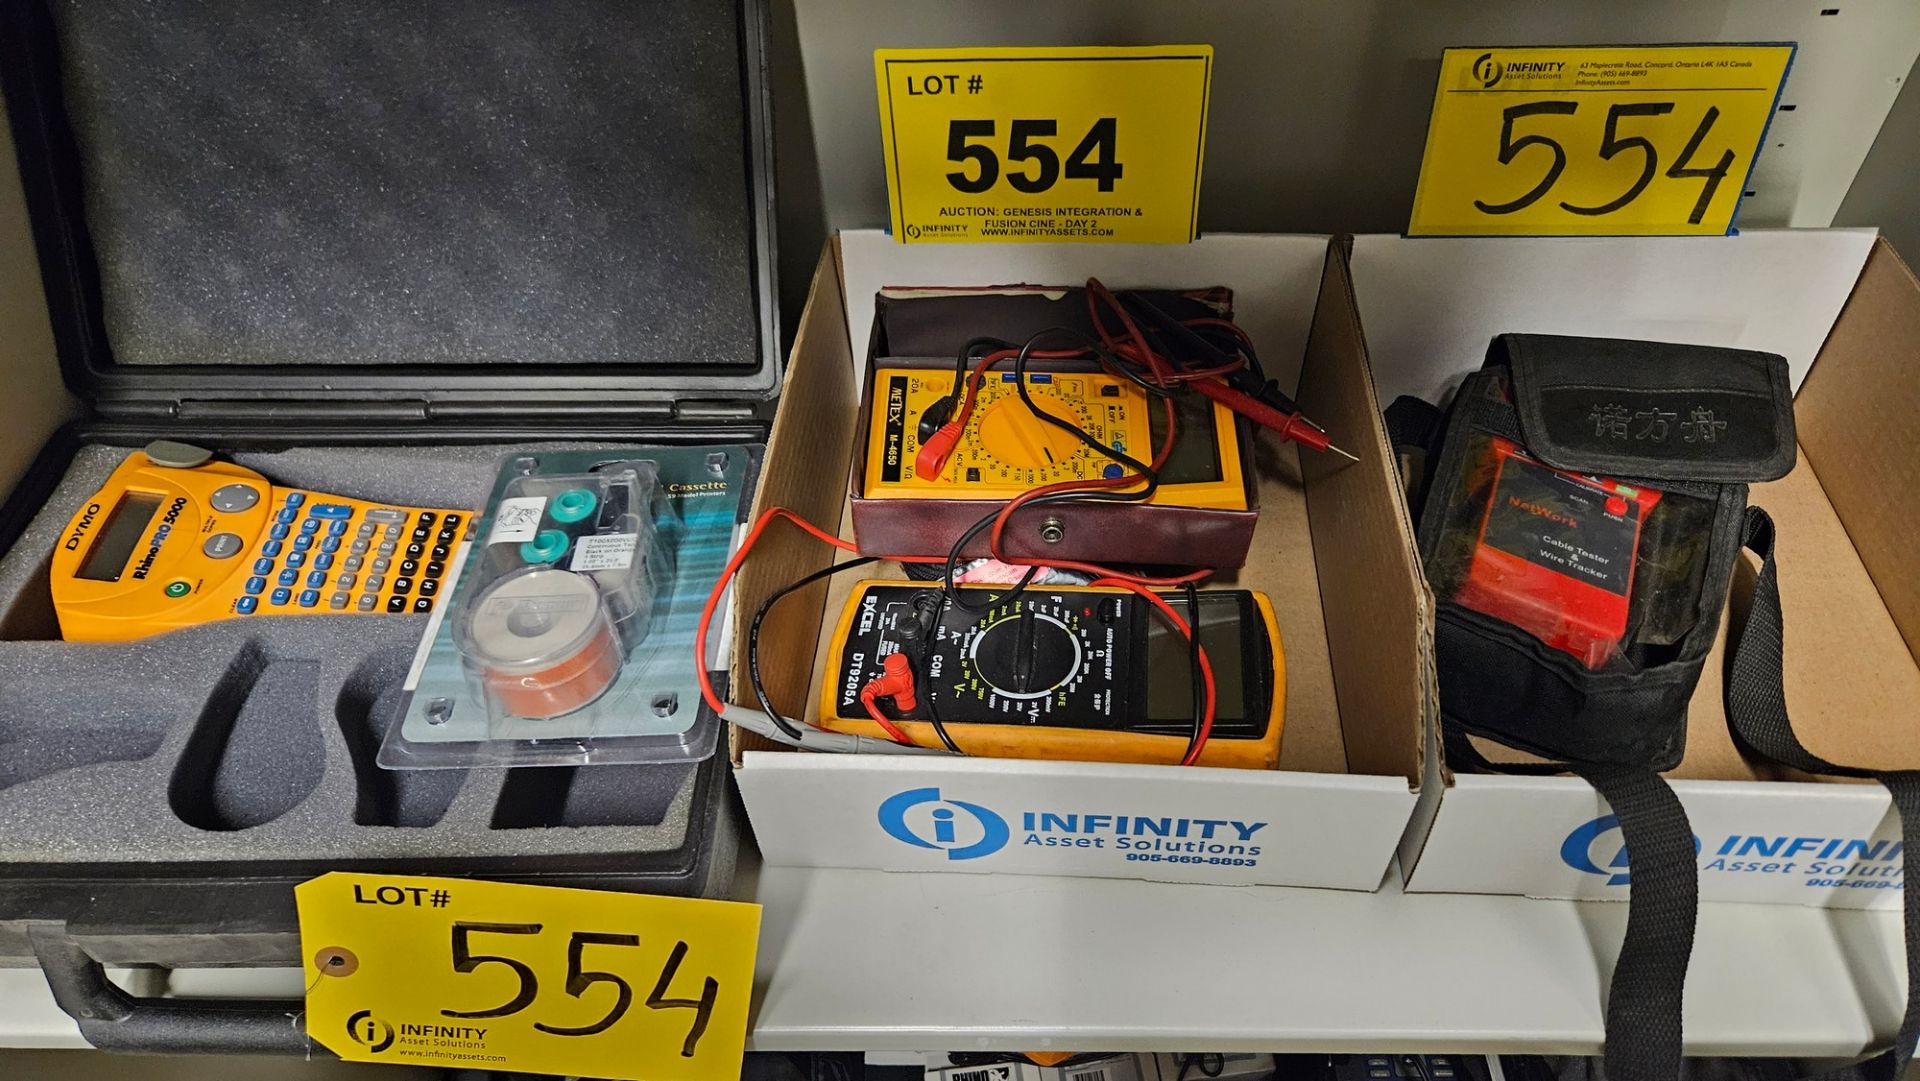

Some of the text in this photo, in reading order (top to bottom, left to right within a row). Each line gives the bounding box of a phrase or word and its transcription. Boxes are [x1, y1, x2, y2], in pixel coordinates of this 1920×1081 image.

[1507, 61, 1565, 72] INFINITY
[1505, 71, 1562, 80] Asset Solutions
[907, 74, 983, 95] LOT #
[945, 117, 1124, 194] 554
[1474, 100, 1736, 224] 554
[939, 207, 1143, 217] AUCTION: GENESIS INTEGRATION &
[985, 220, 1026, 228] FUSION
[1029, 220, 1055, 228] CINE
[1065, 219, 1090, 228] DAY
[1091, 219, 1098, 228] 2
[981, 228, 1114, 237] WWW.INFINITYASSETS.COM
[911, 378, 920, 394] 20A
[1118, 411, 1125, 420] ON
[887, 434, 898, 466] M-4650
[907, 434, 915, 453] COM
[669, 481, 728, 492] Cassette
[1569, 494, 1589, 505] SCAN
[1603, 511, 1624, 523] PUSH
[65, 503, 101, 551] DYMO
[132, 497, 187, 580] RhinoPRO 5000
[1543, 534, 1610, 565] Cable Tester
[1540, 549, 1608, 580] Wire Tracker
[1569, 554, 1580, 562] &
[989, 593, 1000, 602] A
[1051, 595, 1062, 604] F
[936, 626, 947, 641] mA
[843, 595, 878, 706] EXCEL DT9205A
[930, 654, 943, 678] COM
[1057, 692, 1066, 707] hFE
[1023, 811, 1269, 841] INFINITY
[1023, 833, 1262, 857] Asset Solutions
[1715, 834, 1905, 862] INFINI
[1126, 853, 1257, 867] 905-669-8893
[1703, 858, 1799, 875] Asset
[354, 884, 451, 908] LOT#
[441, 921, 719, 1056] 554
[400, 1023, 488, 1040] INFINITY
[399, 1036, 487, 1049] Asset Solutions
[399, 1048, 507, 1063] www.infinityassets.com
